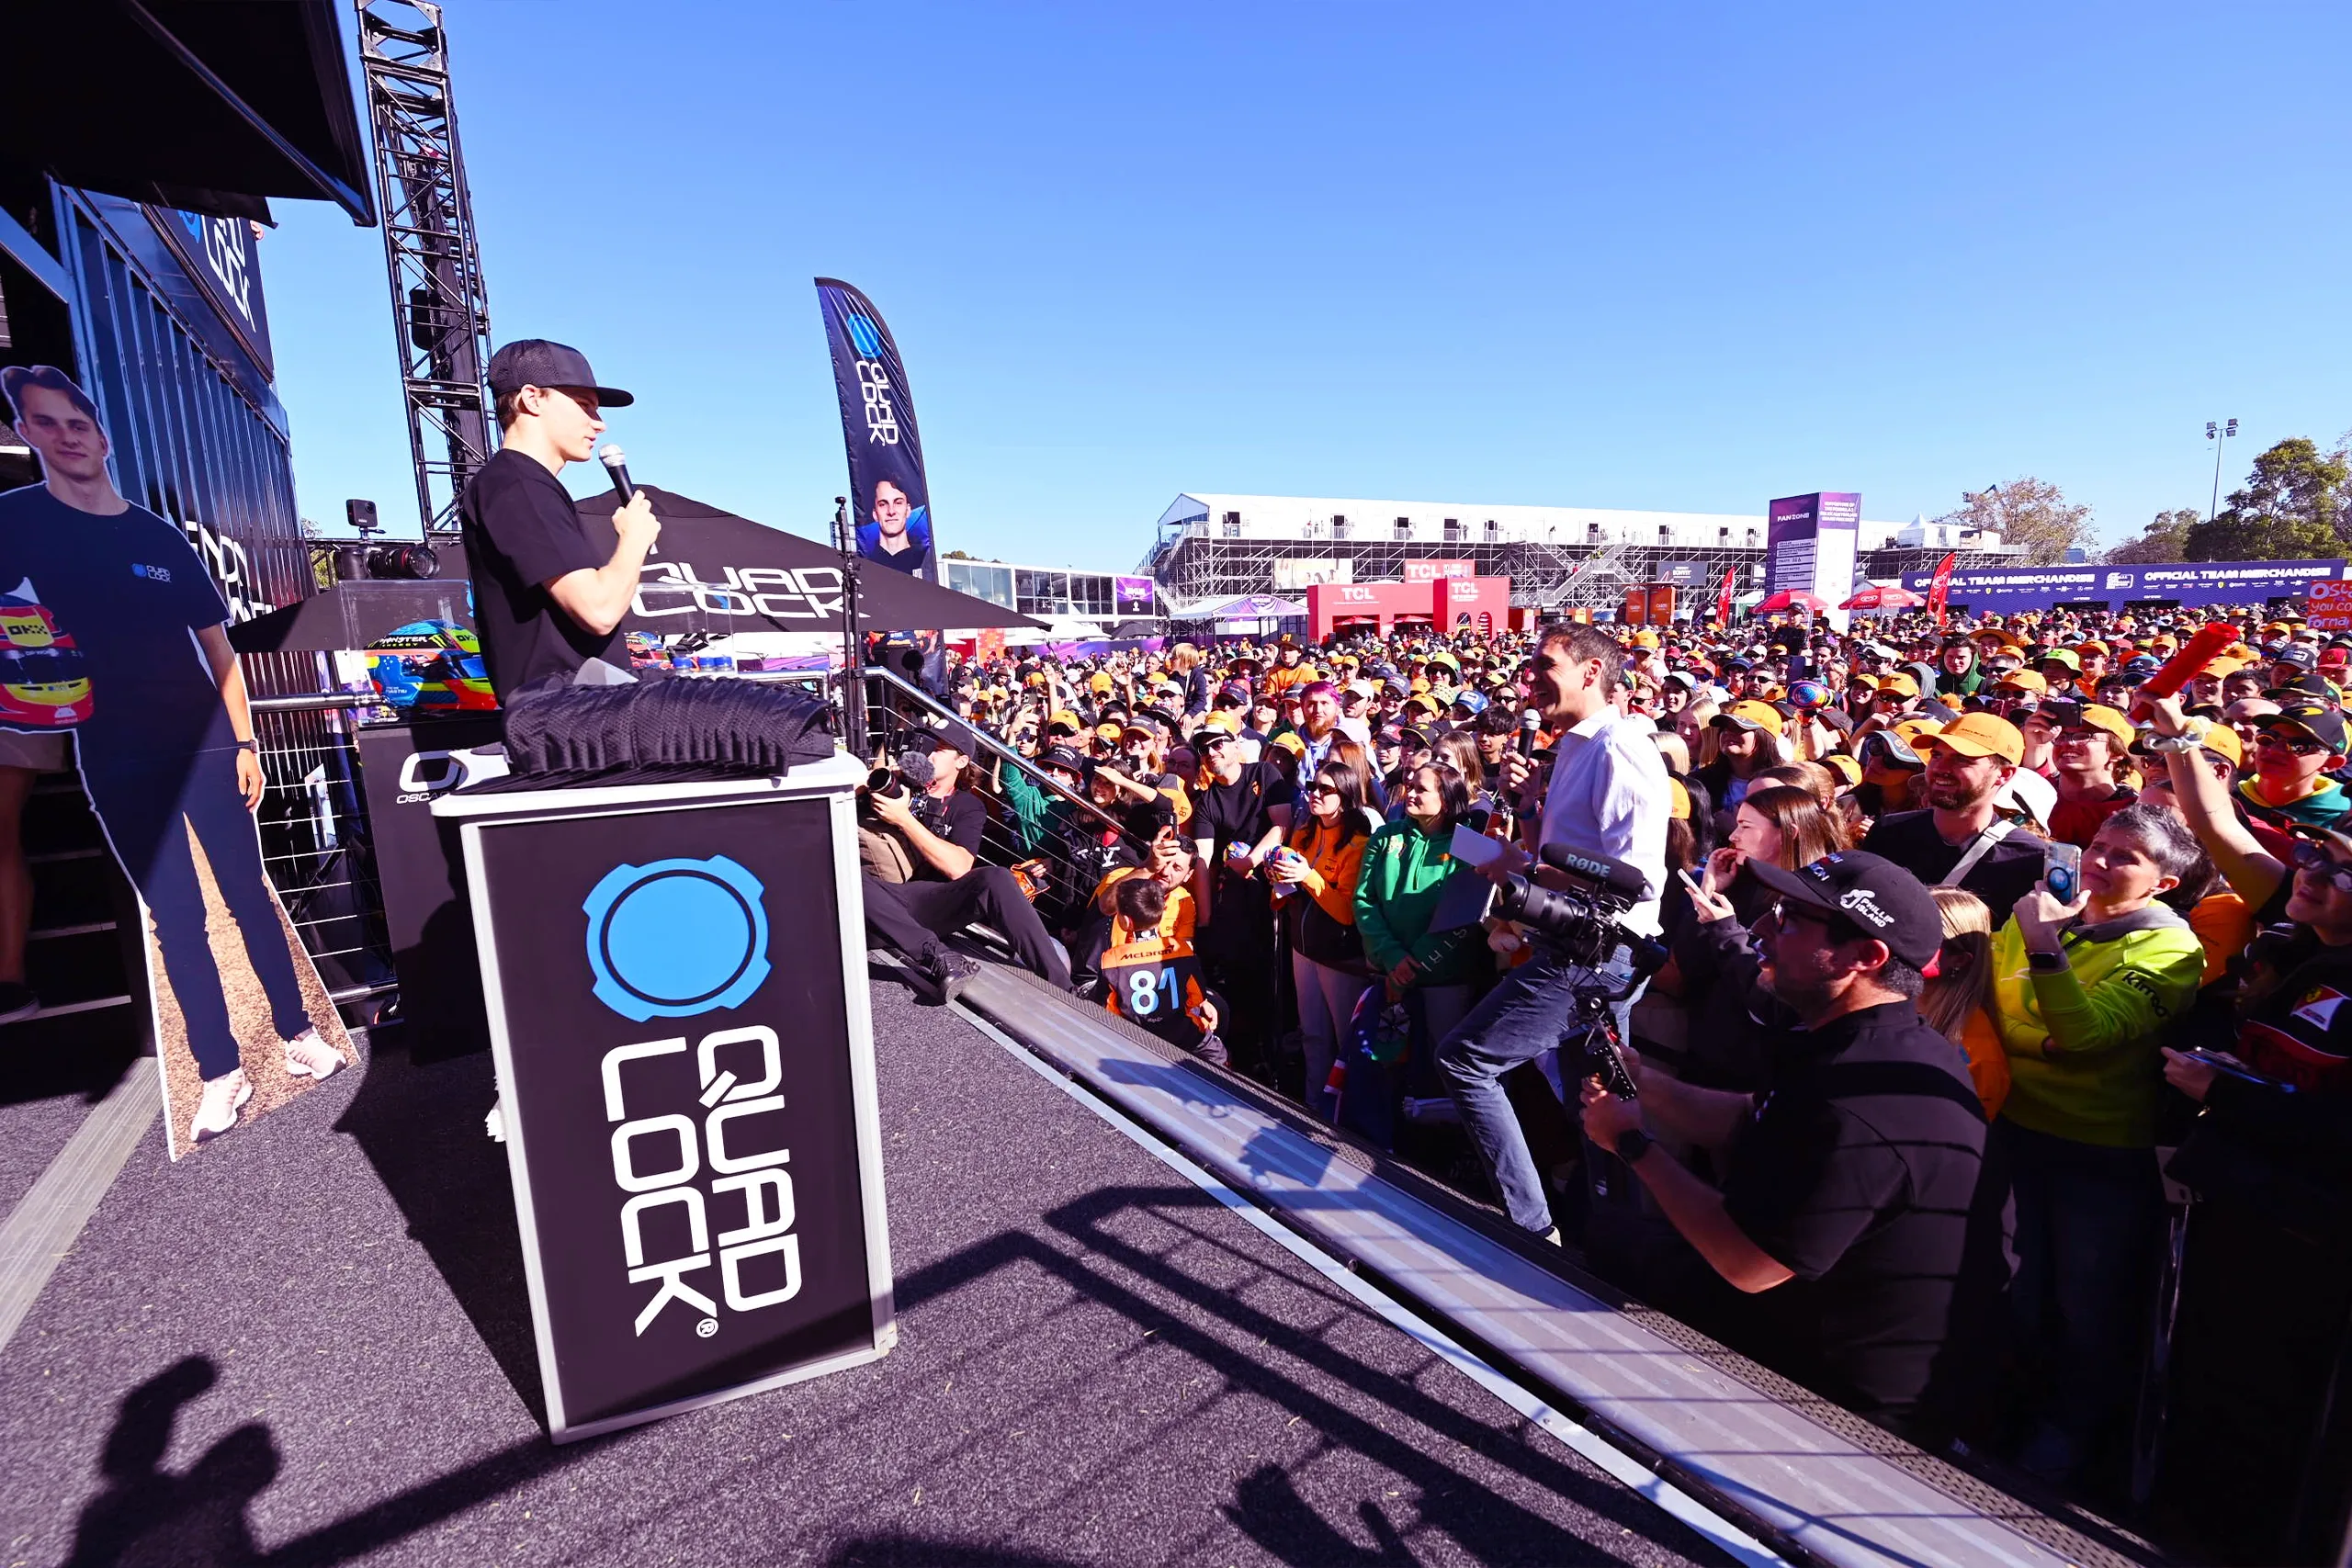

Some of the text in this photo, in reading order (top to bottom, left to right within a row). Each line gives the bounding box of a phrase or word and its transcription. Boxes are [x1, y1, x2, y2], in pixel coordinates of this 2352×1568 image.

[855, 360, 886, 446] LOCK
[870, 362, 899, 445] QUAD
[639, 561, 844, 594] QUAD
[1407, 564, 1442, 578] TCL
[1914, 578, 1967, 588] OFIAL
[1968, 576, 2006, 586] TEAM
[2007, 574, 2096, 585] MERCHANDISE
[2144, 570, 2199, 581] OFFICIAL
[2200, 570, 2239, 581] TEAM
[2240, 567, 2332, 579] MERCHANDISE
[1341, 587, 1375, 600] TCL
[1451, 581, 1479, 594] TCL
[630, 588, 872, 619] LOCK
[8, 625, 48, 636] OKX
[396, 792, 449, 805] OSCA
[1566, 852, 1611, 878] RØDE
[1854, 903, 1887, 928] ISLAND
[1860, 897, 1895, 924] PHILLIP
[1120, 945, 1172, 961] McLaren
[1129, 966, 1180, 1015] 81
[696, 1023, 803, 1314] QUAD
[602, 1036, 719, 1338] LOCK
